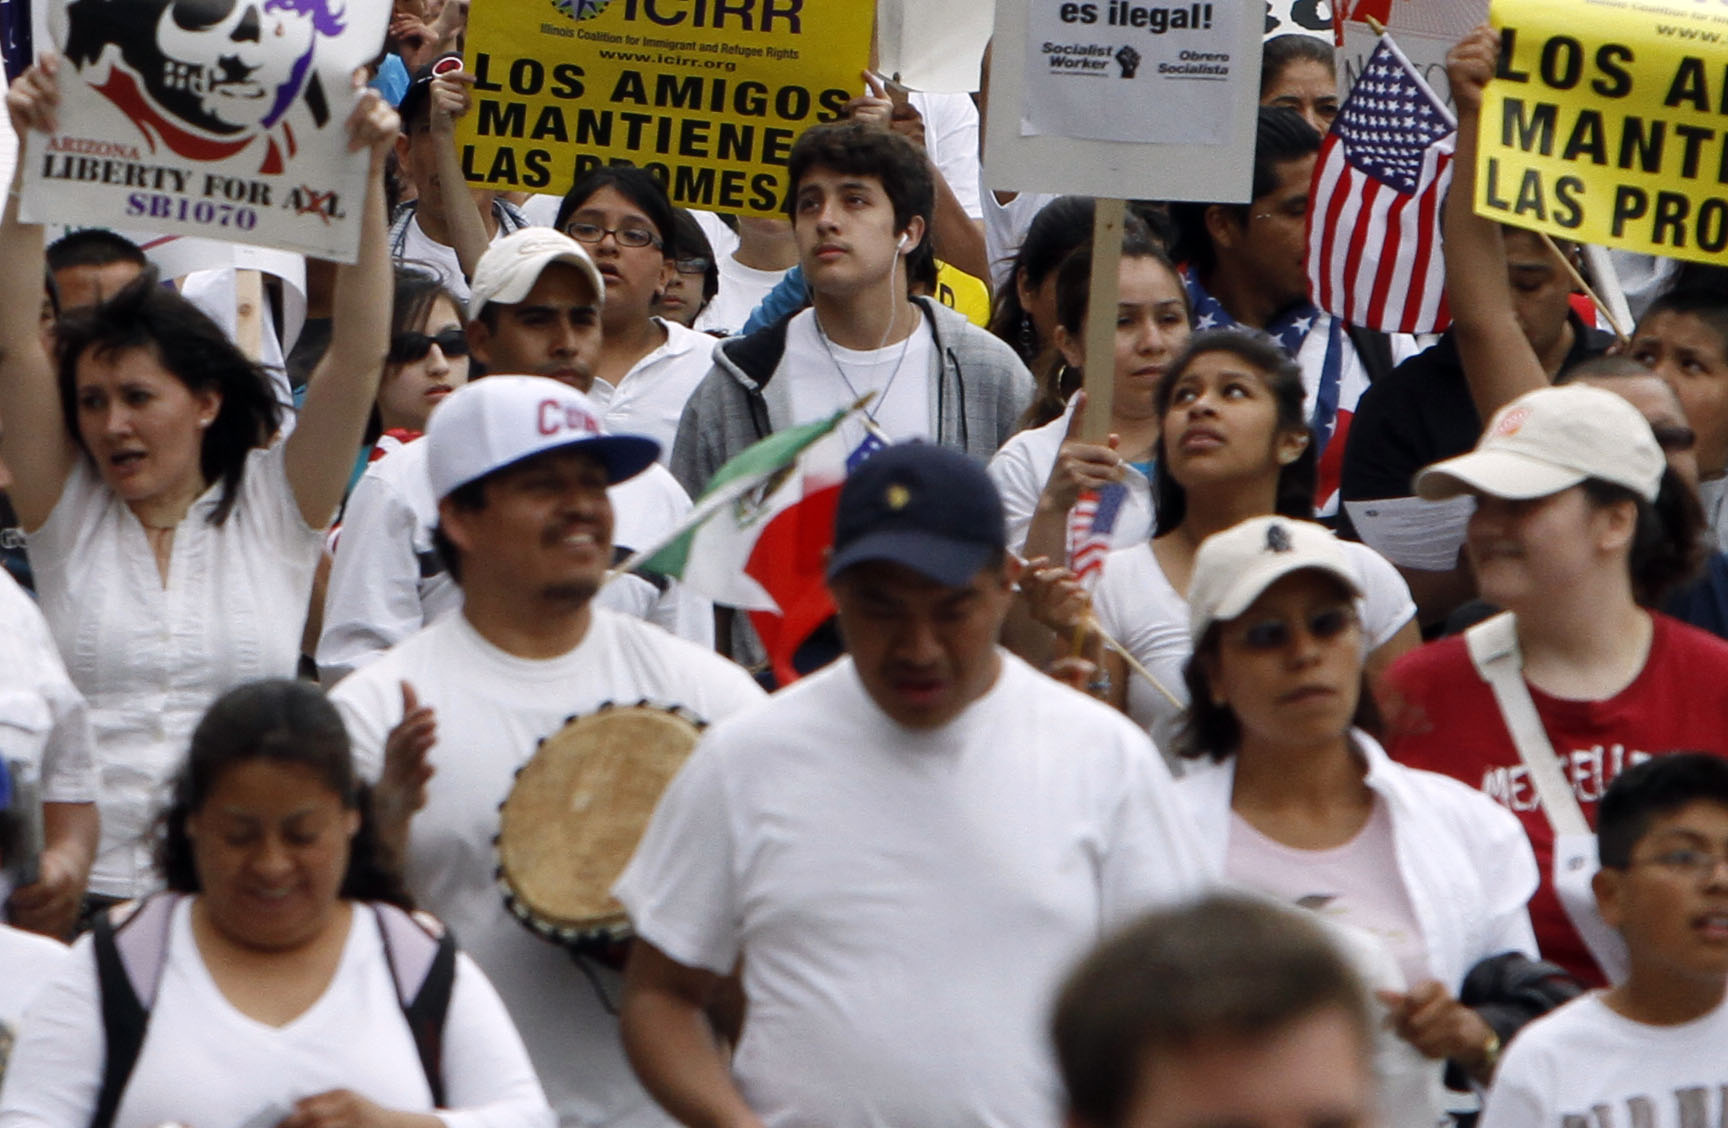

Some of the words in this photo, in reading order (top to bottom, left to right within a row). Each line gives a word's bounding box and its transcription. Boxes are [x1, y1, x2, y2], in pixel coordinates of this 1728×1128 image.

[1058, 2, 1099, 25] es
[1107, 0, 1214, 35] ilegal!
[540, 22, 576, 39] Illinois
[576, 27, 624, 46] Coalition
[624, 33, 640, 46] for
[642, 35, 697, 54] Immigrant
[698, 40, 719, 53] and
[720, 42, 764, 60] Refugee
[765, 45, 800, 61] Rights
[598, 48, 737, 72] www.icirr.org
[1040, 41, 1115, 59] Socialist
[1178, 50, 1231, 64] Obrero
[1049, 55, 1111, 72] Worker
[1158, 61, 1231, 76] Socialista
[1495, 26, 1637, 100] LOS
[473, 52, 587, 100] LOS
[609, 68, 852, 124] AMIGOS
[45, 136, 142, 162] ARIZONA
[476, 99, 794, 167] MANTIENE
[41, 153, 193, 194] LIBERTY
[202, 173, 274, 208] FOR
[461, 143, 553, 189] LAS
[125, 190, 259, 232] SB1070
[1486, 157, 1587, 230] LAS
